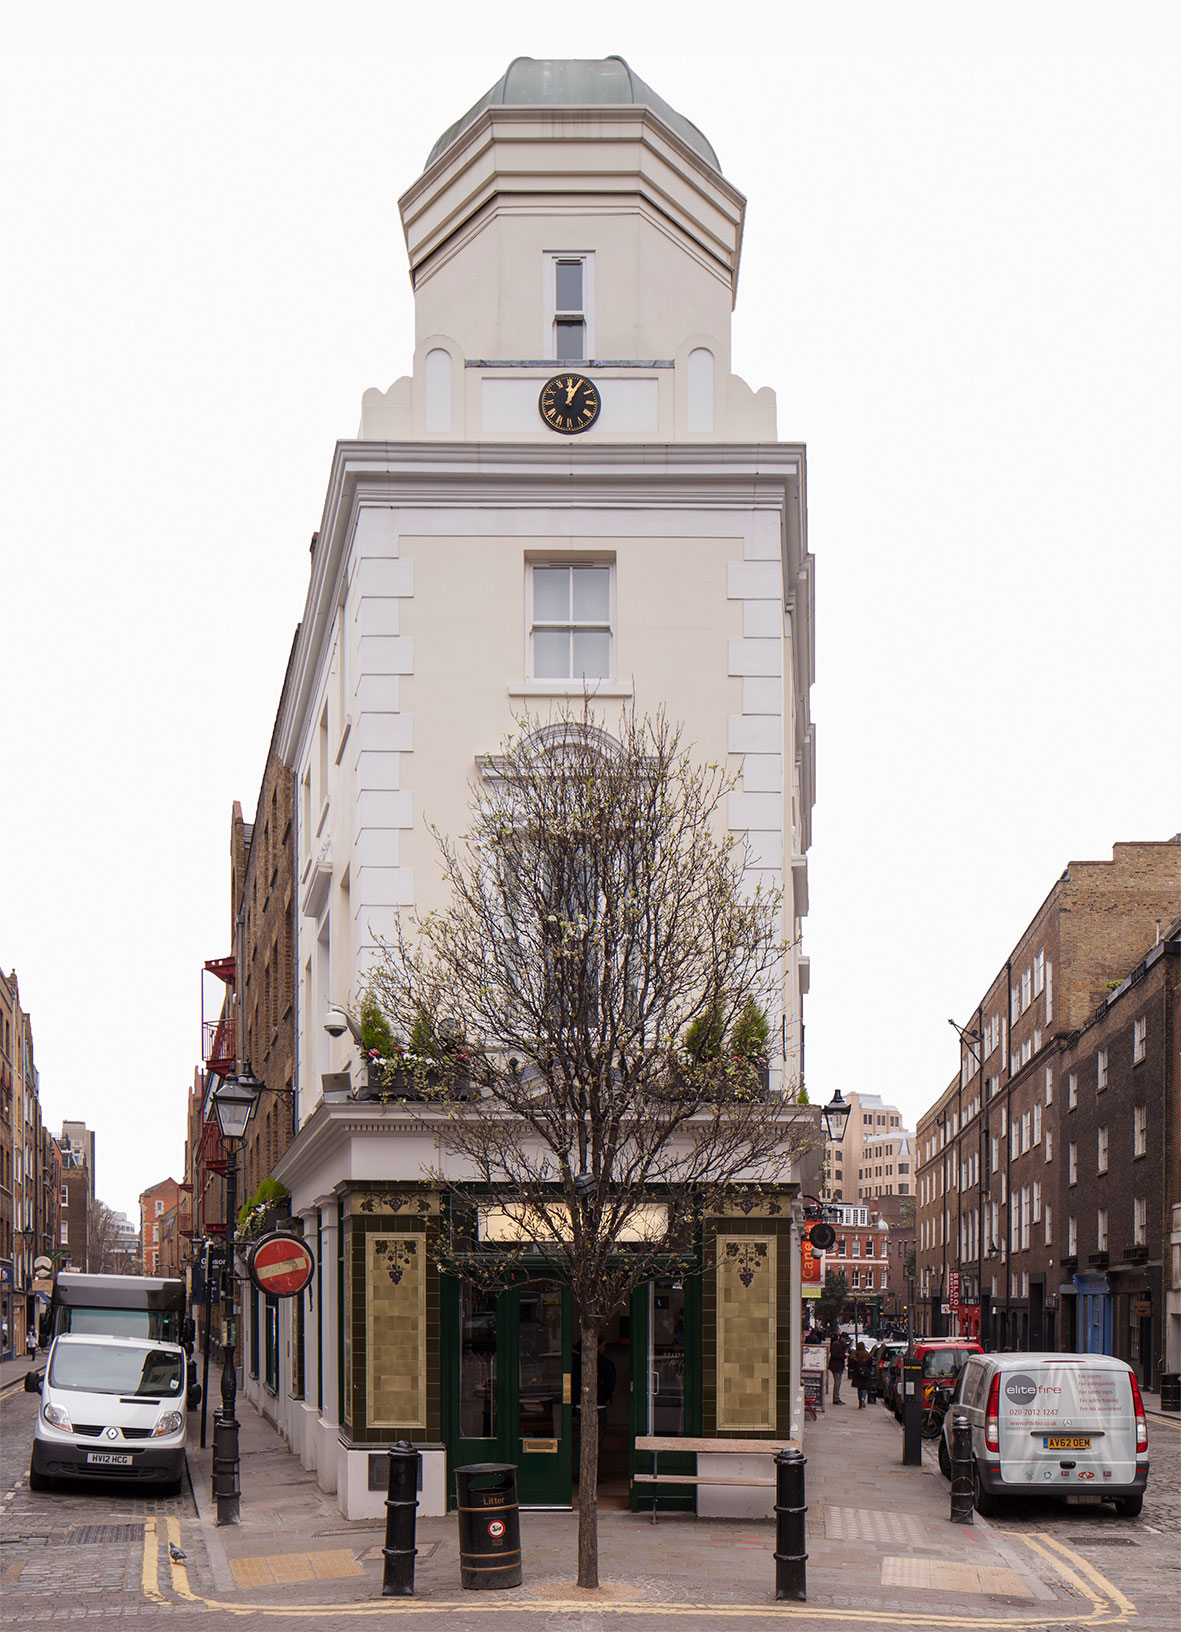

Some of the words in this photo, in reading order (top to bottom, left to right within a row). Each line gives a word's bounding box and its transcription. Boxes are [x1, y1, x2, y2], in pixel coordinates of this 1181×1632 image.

[1006, 1384, 1036, 1395] elite
[1038, 1384, 1062, 1394] fire
[1049, 1439, 1072, 1447] AV62
[92, 1454, 111, 1463] HV12
[111, 1455, 128, 1464] HCG
[483, 1496, 505, 1505] Litter
